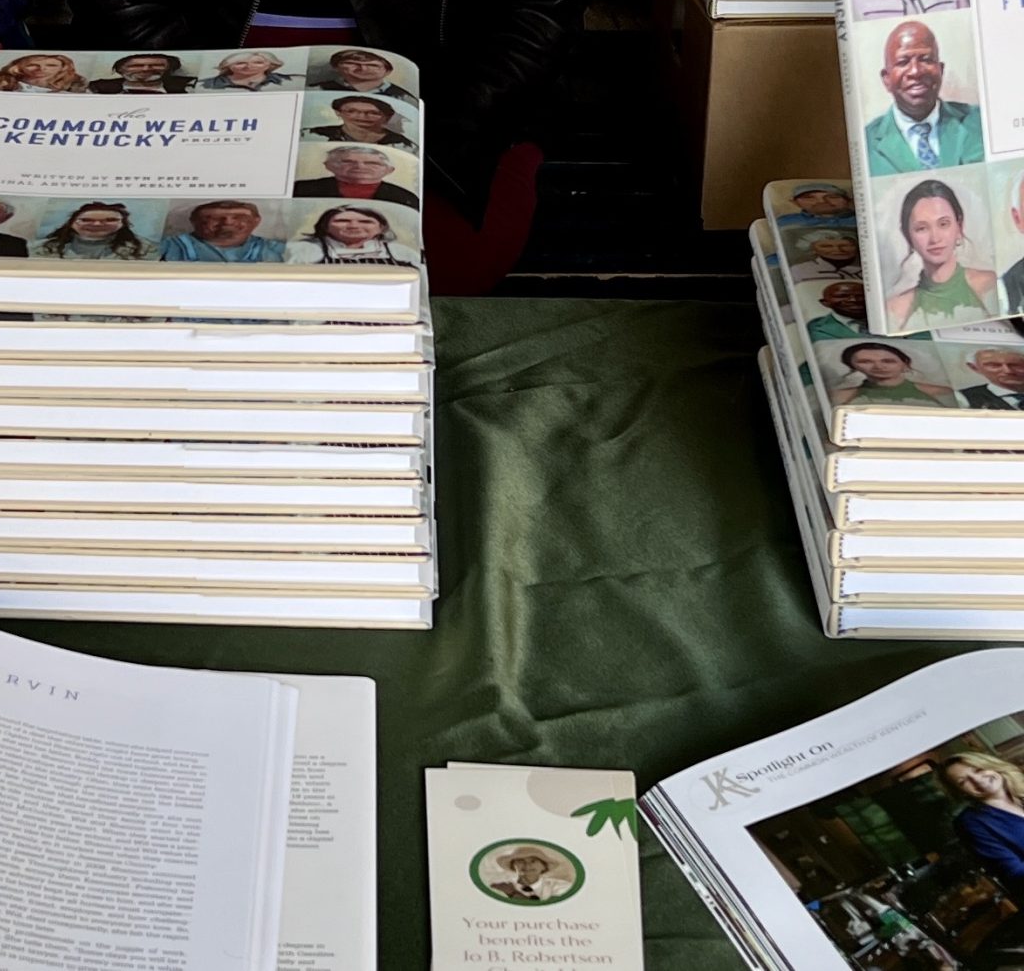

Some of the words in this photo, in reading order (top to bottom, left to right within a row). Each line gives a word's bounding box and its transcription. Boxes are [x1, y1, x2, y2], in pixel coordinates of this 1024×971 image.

[146, 118, 258, 132] WEALTH
[5, 132, 176, 147] KENTUCKY
[735, 751, 807, 783] Spotlight
[808, 740, 835, 756] On
[462, 917, 507, 930] Your
[514, 919, 600, 932] purchase
[478, 934, 555, 946] benefits
[561, 935, 593, 947] the
[488, 950, 505, 963] B.
[512, 951, 614, 964] Robertson
